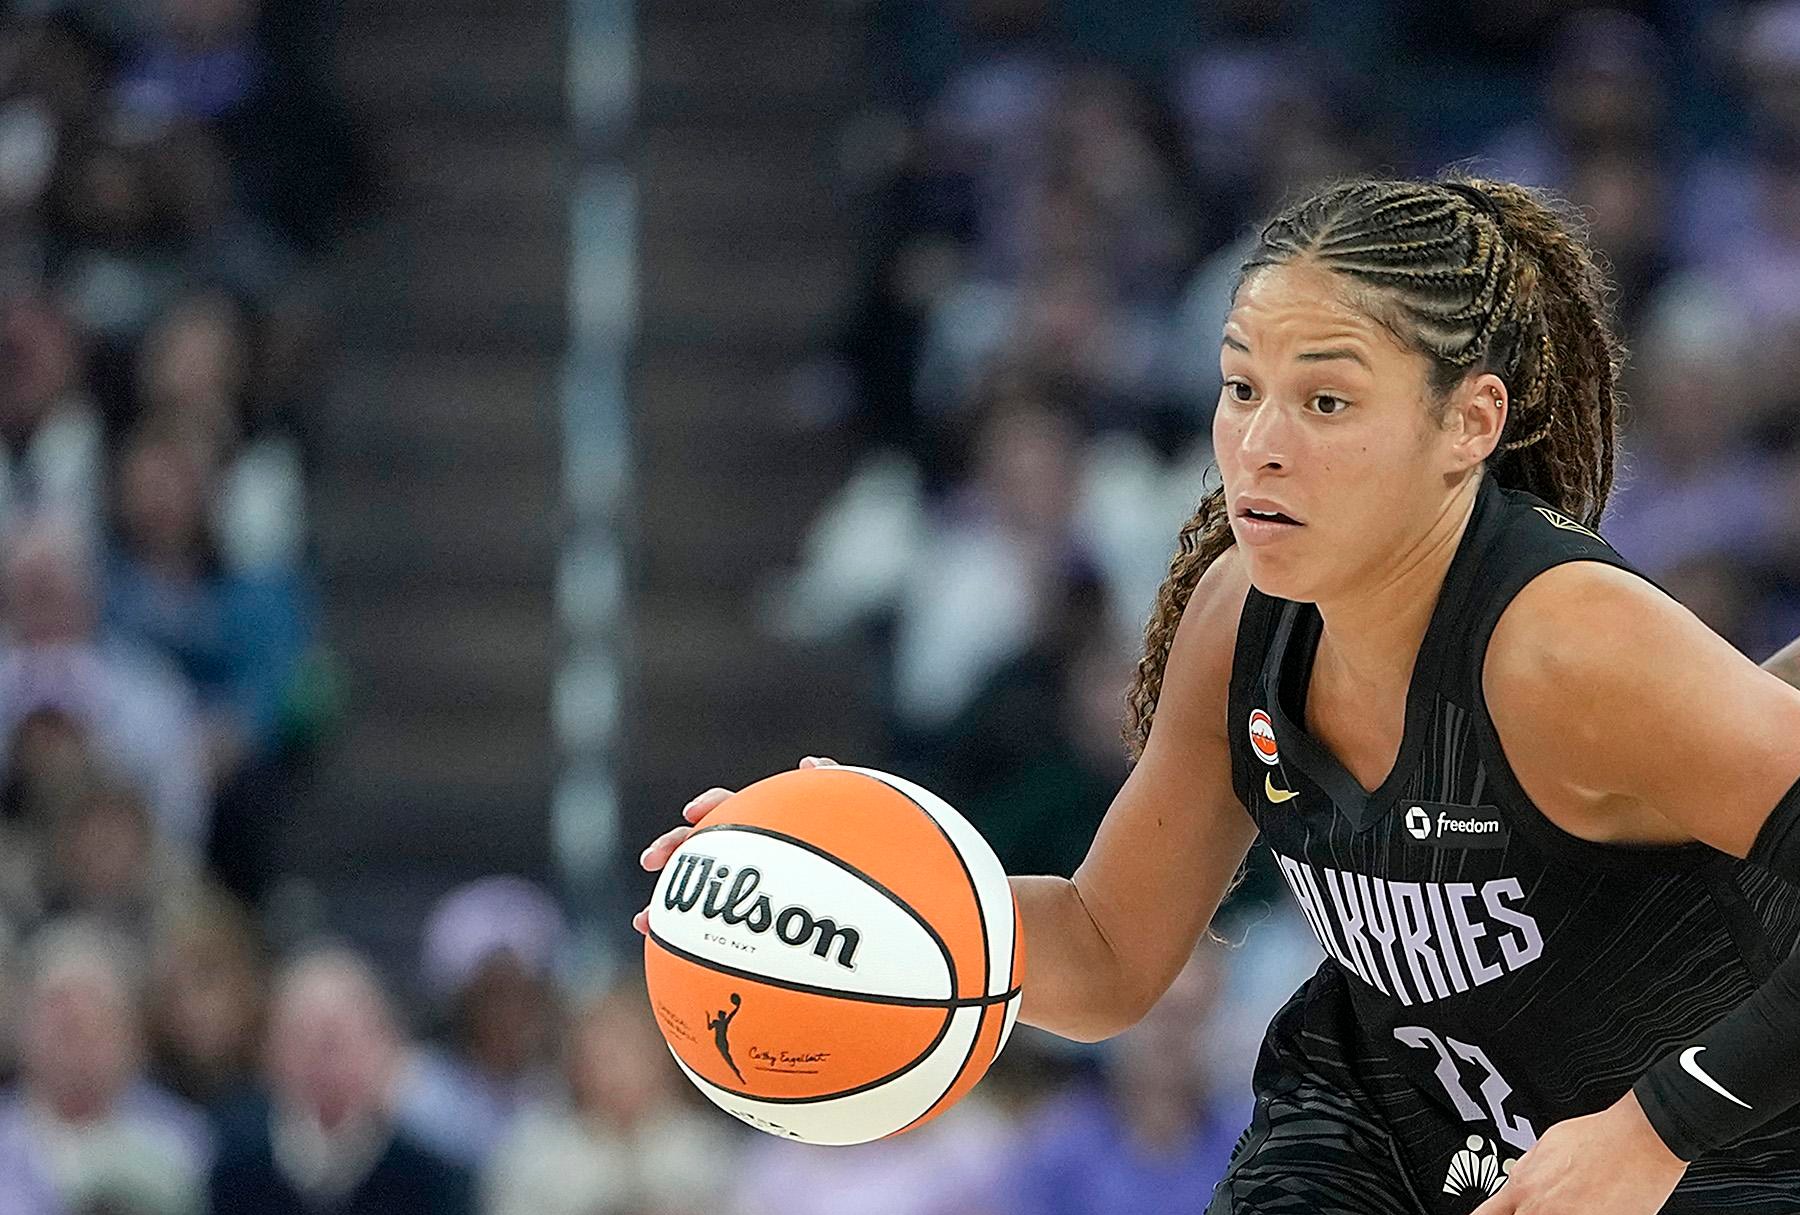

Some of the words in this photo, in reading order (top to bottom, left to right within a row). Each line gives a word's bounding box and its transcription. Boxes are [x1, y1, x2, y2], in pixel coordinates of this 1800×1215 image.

[1437, 811, 1499, 838] freedom
[664, 853, 861, 970] Wilson
[704, 933, 727, 945] EVO
[731, 940, 756, 953] NXT
[1271, 847, 1544, 1006] ALKYRIES
